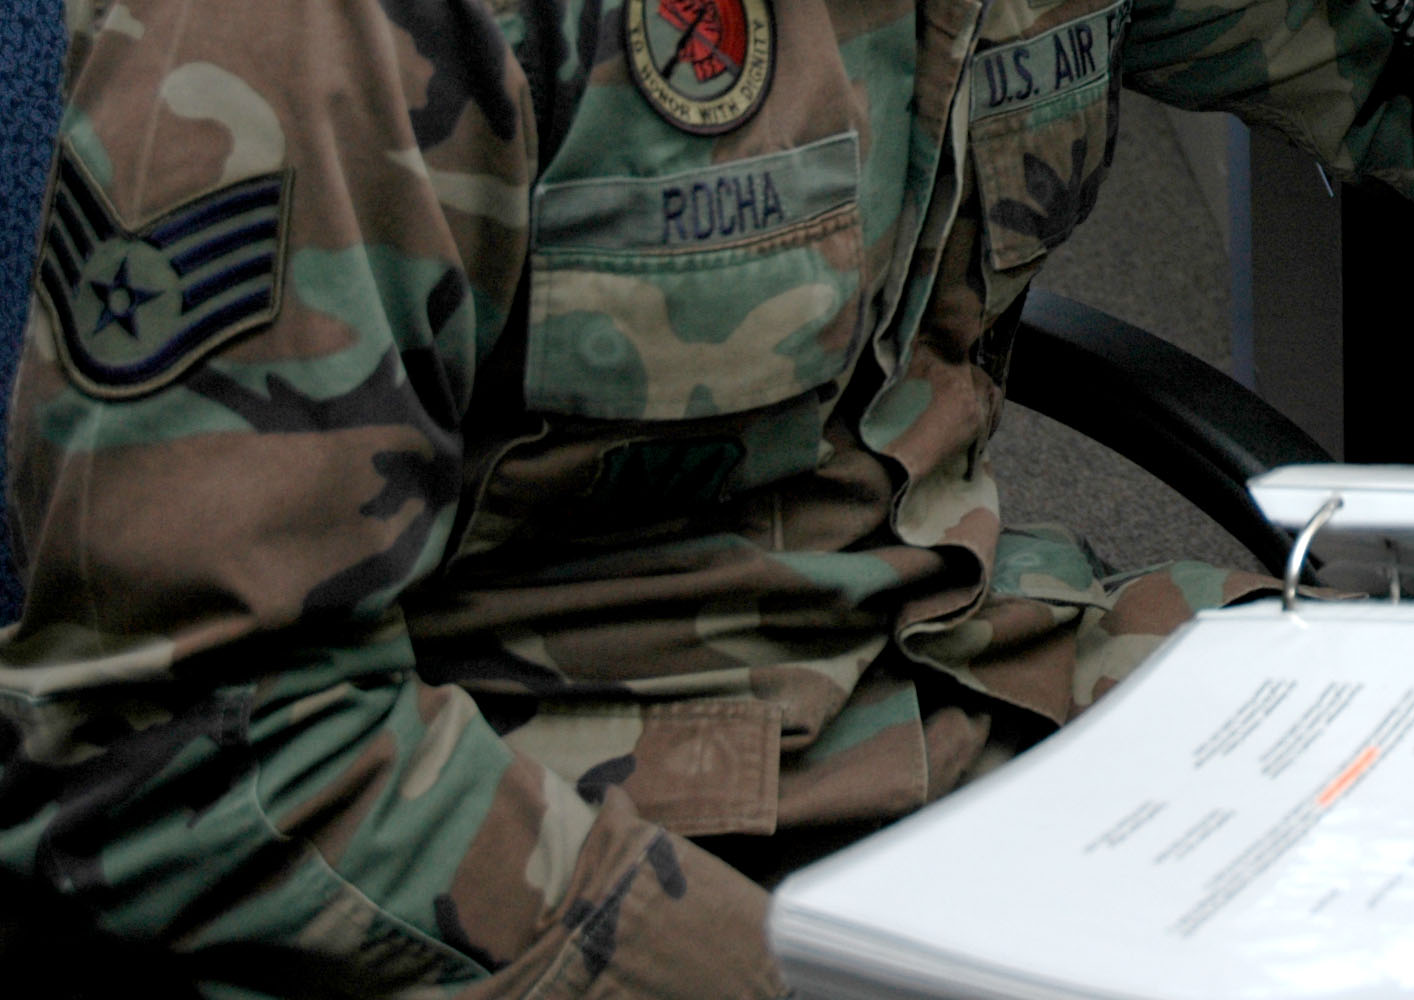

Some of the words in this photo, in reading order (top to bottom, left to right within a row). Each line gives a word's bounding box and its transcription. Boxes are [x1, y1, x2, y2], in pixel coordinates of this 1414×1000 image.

[740, 18, 767, 99] DIGNITY
[984, 47, 1040, 108] U.S.
[1052, 23, 1096, 91] AIR
[662, 171, 784, 245] ROCHA
